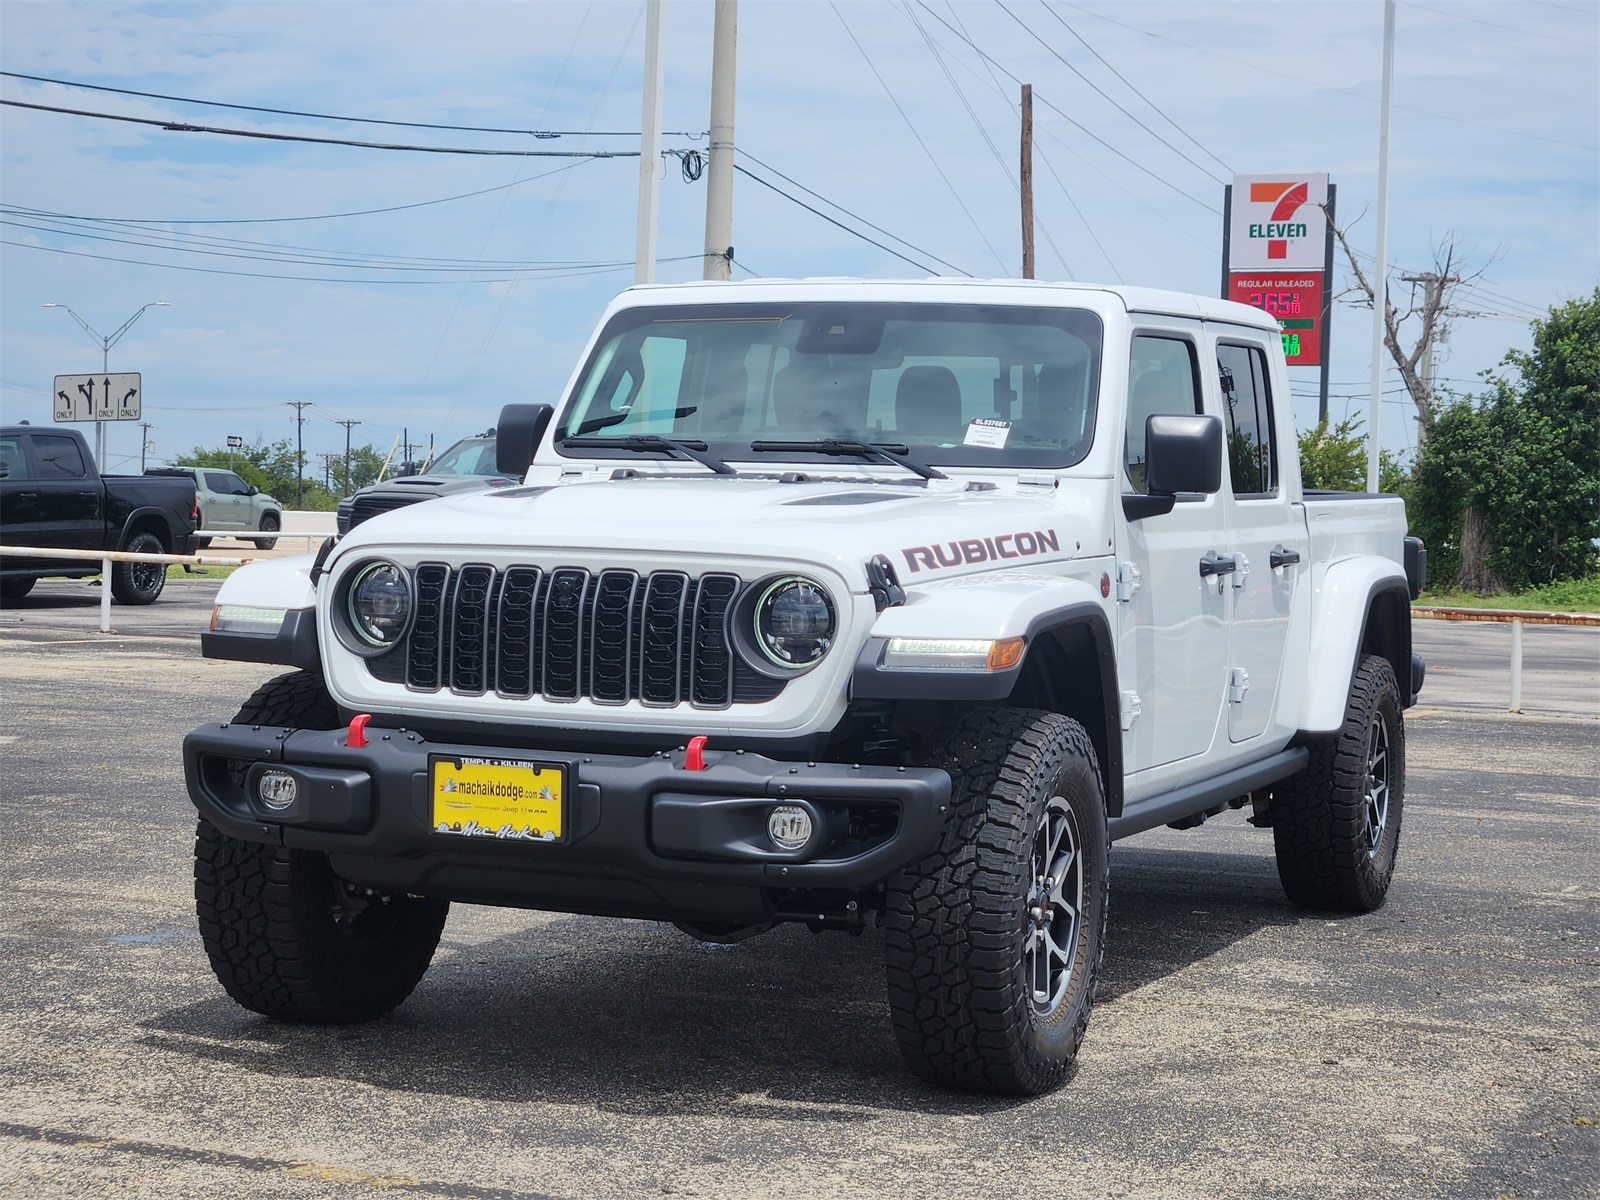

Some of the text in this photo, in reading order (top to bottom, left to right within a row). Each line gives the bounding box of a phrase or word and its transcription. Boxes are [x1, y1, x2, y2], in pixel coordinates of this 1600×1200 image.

[1249, 182, 1308, 259] 7
[1237, 280, 1315, 288] REGULAR UNLEADED
[56, 410, 73, 419] ONLY
[98, 409, 114, 418] ONLY
[120, 408, 138, 417] ONLY
[901, 529, 1060, 573] RUBICON
[460, 757, 534, 769] TEMPLE KILLEEN
[458, 779, 538, 801] machaikdodge.com
[502, 806, 519, 814] Jeep
[460, 820, 531, 839] Mac Haik
